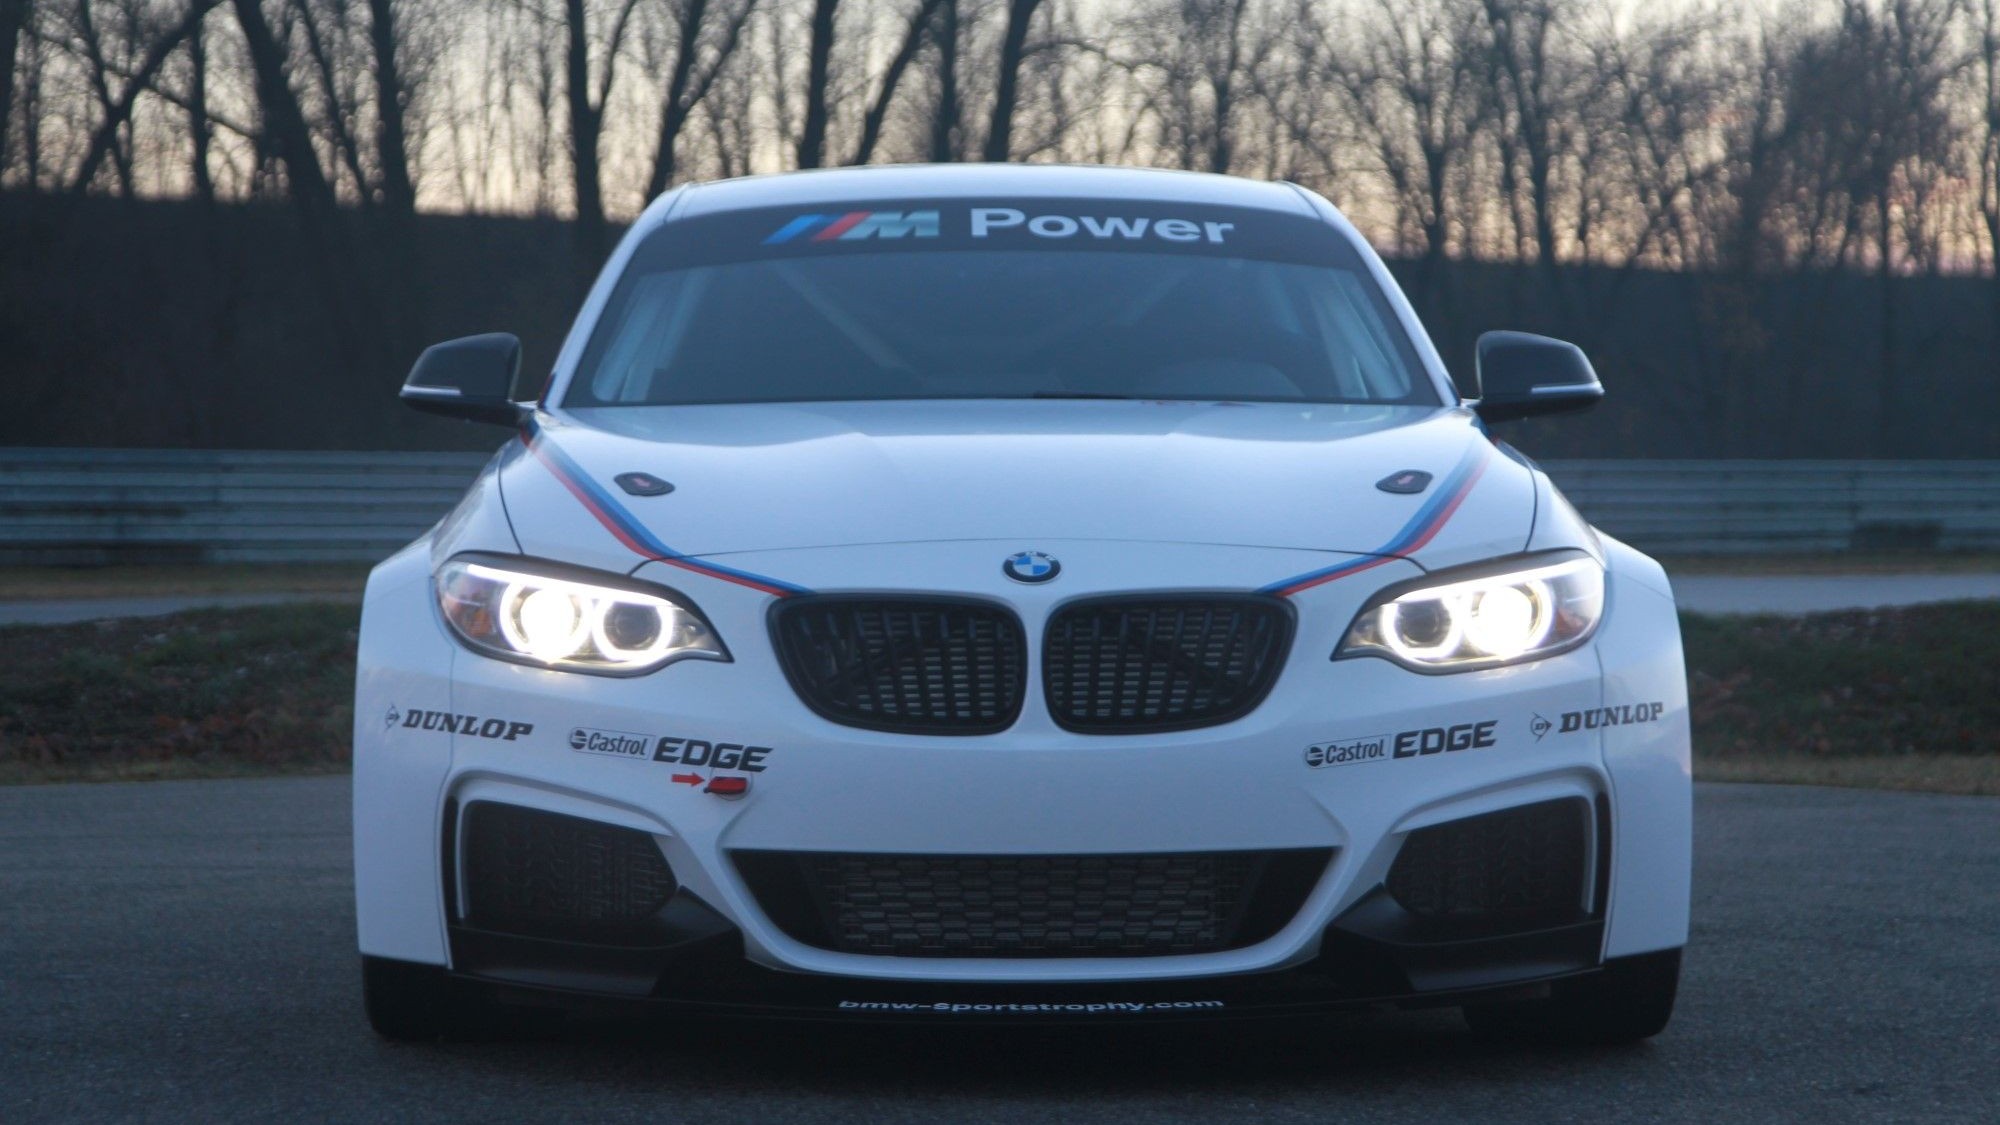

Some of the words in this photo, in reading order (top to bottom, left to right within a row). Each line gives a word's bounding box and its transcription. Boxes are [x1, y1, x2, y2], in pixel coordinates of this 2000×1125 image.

[970, 208, 1234, 243] Power
[402, 709, 533, 741] DUNLOP
[1559, 702, 1664, 733] DUNLOP
[587, 732, 647, 757] Castrol
[653, 736, 773, 772] EDGE
[1325, 738, 1384, 764] Castrol
[1392, 720, 1498, 759] EDGE
[838, 999, 1225, 1012] bmw-sportstrophy.com
